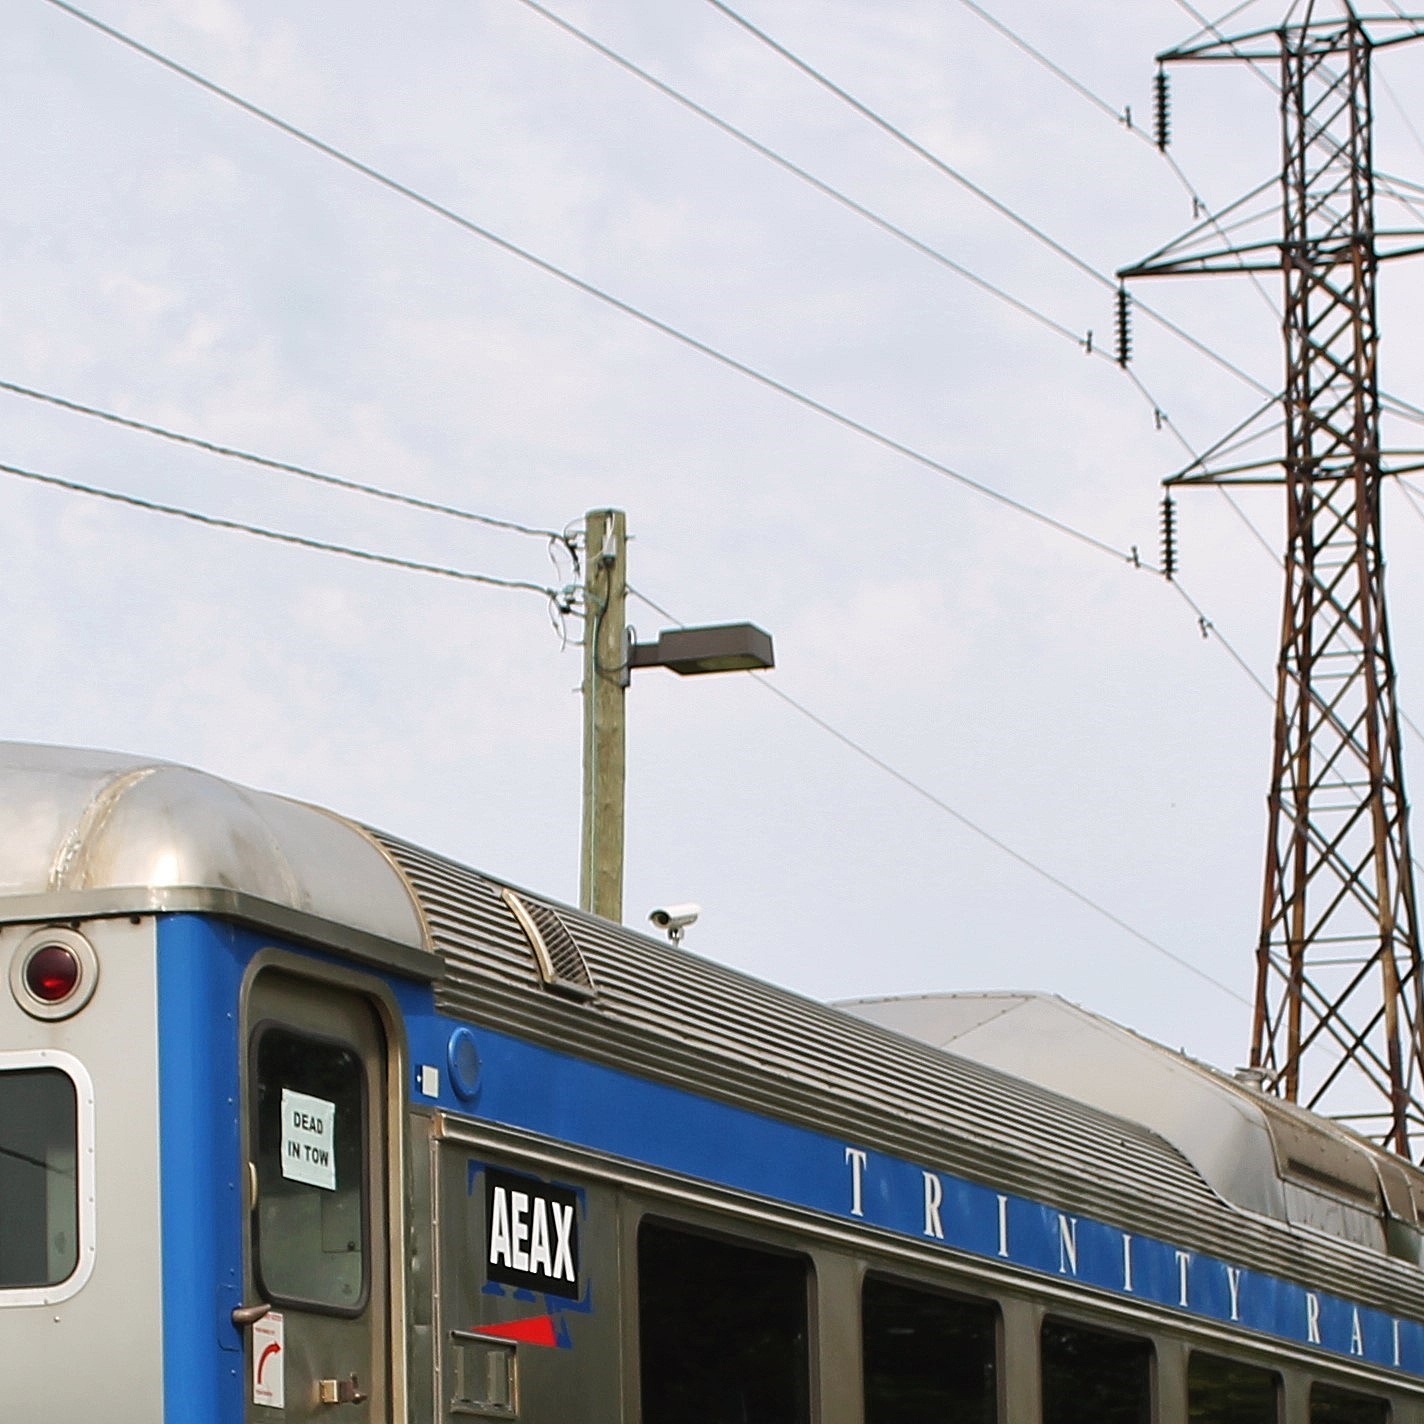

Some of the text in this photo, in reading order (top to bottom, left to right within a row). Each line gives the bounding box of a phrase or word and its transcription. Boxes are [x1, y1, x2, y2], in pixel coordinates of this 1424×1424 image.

[293, 1111, 323, 1135] DEAD
[287, 1141, 329, 1167] IN TOW
[490, 1186, 575, 1282] AEAX
[845, 1147, 1243, 1321] TRINITY
